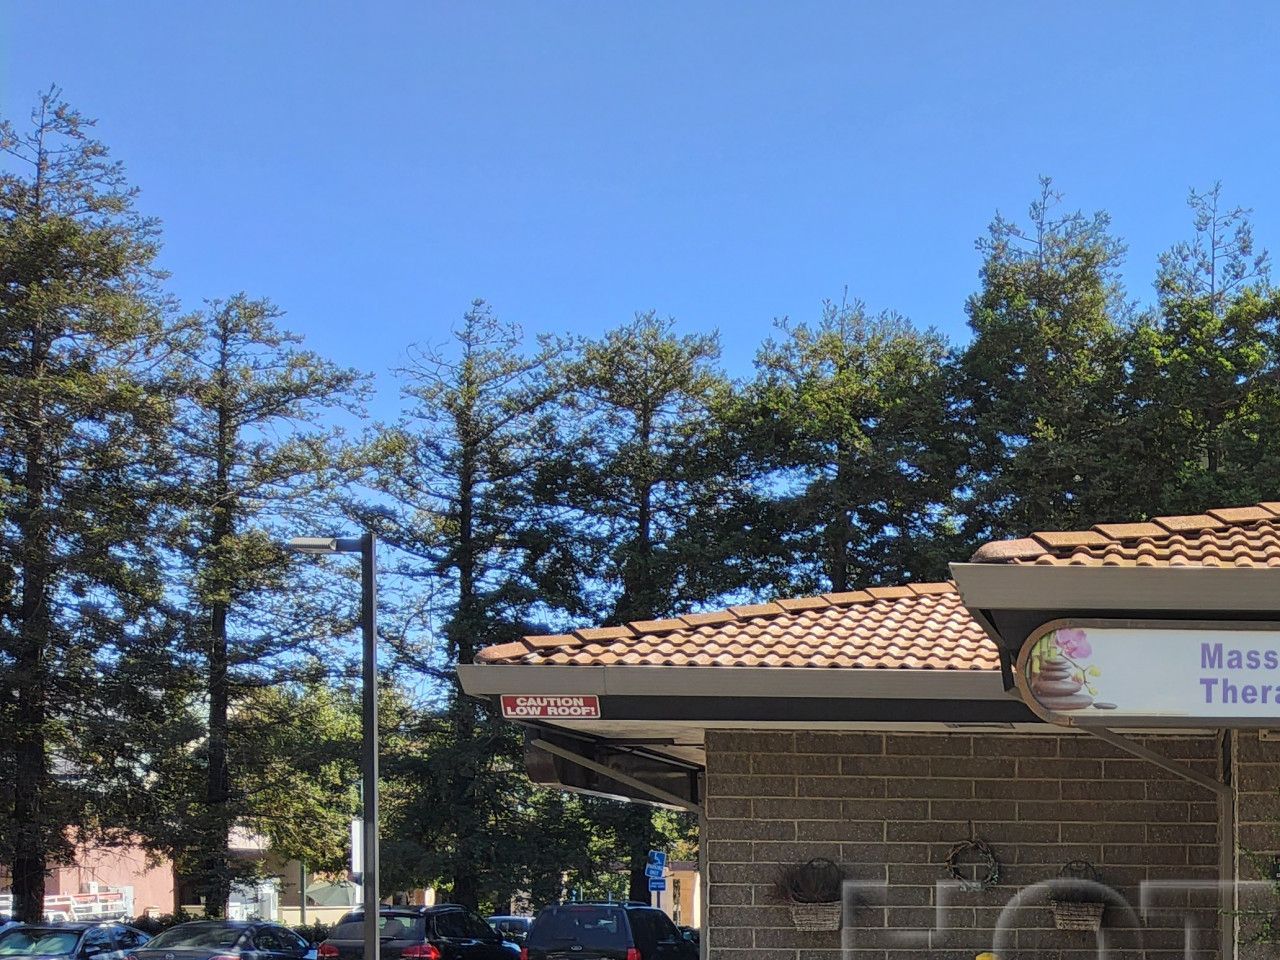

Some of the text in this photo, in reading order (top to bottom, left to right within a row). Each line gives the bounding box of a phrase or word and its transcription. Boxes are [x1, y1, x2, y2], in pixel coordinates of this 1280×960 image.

[516, 697, 584, 706] CAUTION
[506, 706, 596, 716] LOW ROOF!
